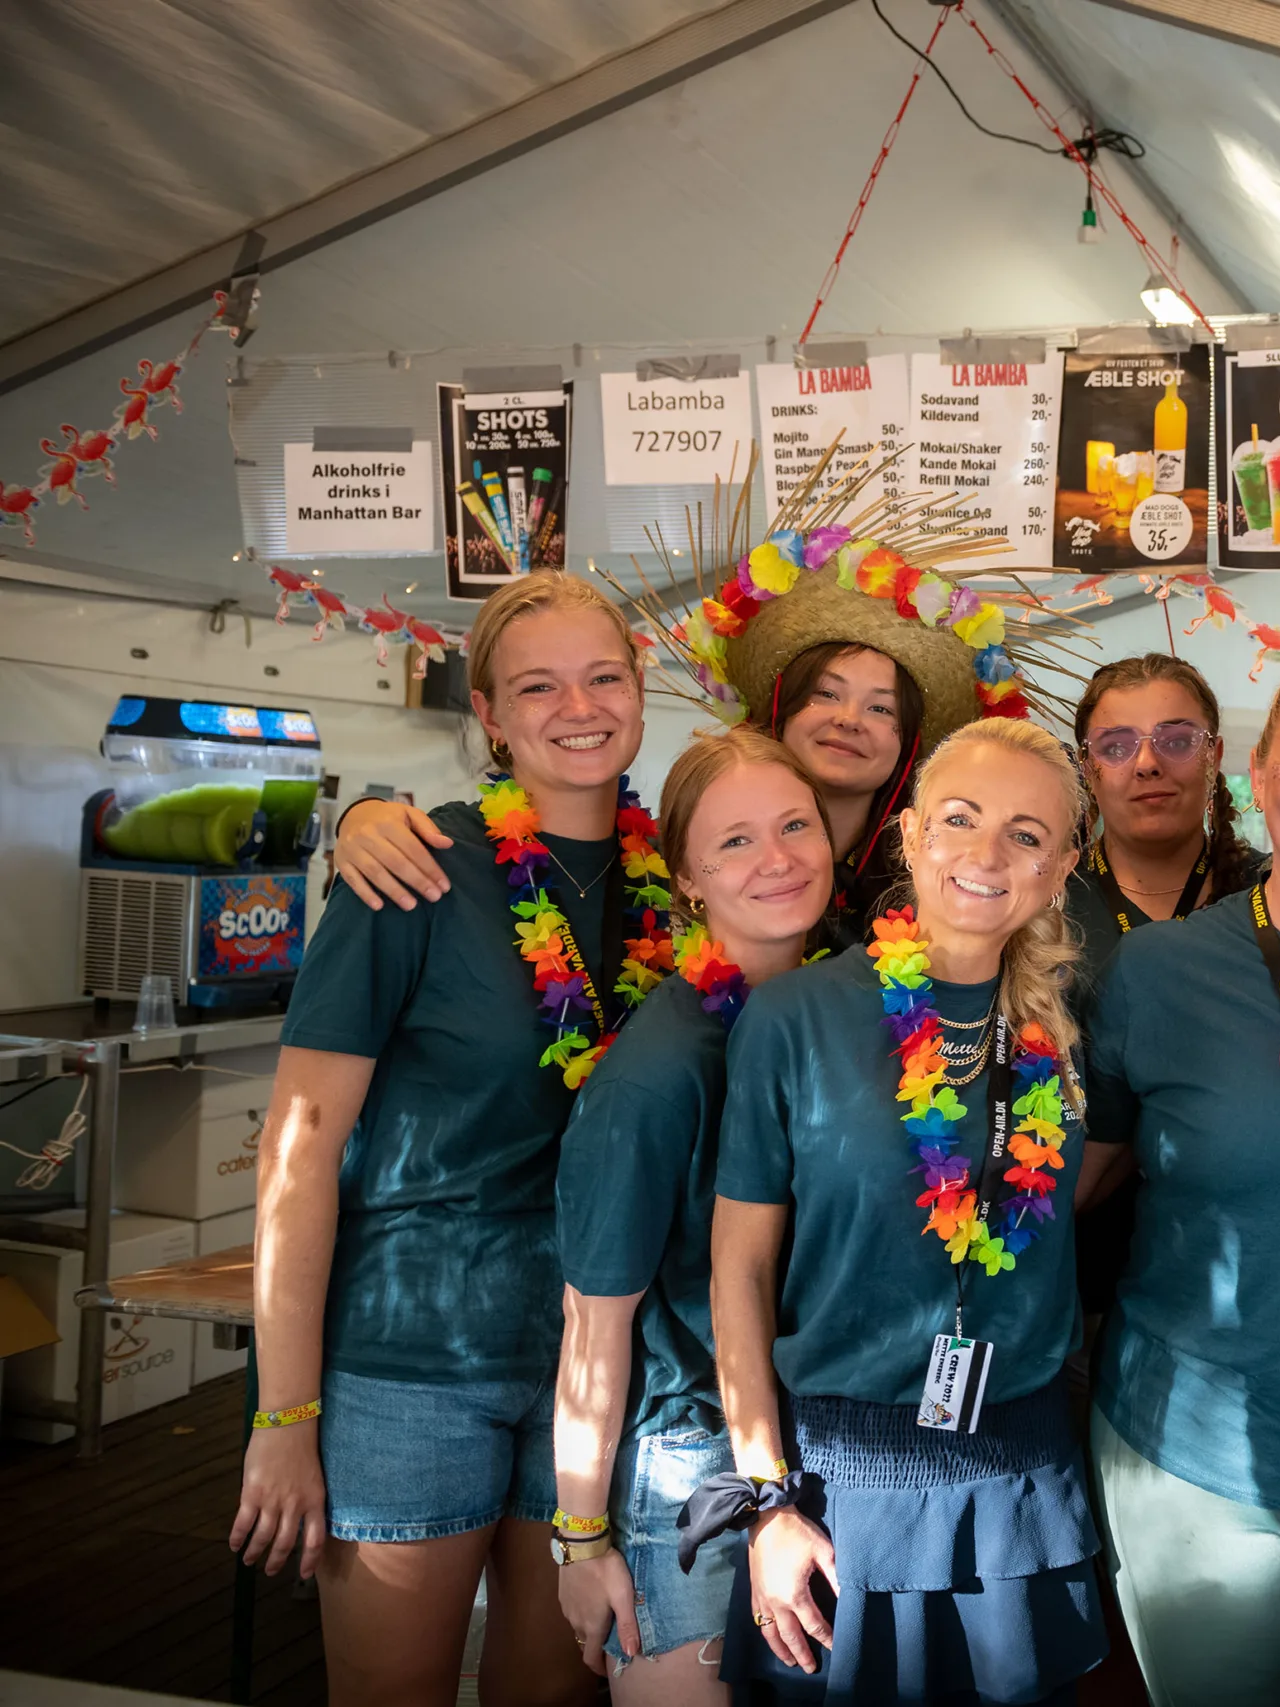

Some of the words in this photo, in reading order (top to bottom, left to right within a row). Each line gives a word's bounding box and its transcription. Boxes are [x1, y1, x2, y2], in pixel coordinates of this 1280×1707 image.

[798, 371, 816, 395] LA
[820, 366, 872, 393] BAMBA
[952, 363, 970, 386] LA
[974, 363, 1028, 386] BAMBA
[1084, 371, 1133, 387] ÆBLE
[1137, 370, 1185, 387] SHOT
[627, 391, 725, 411] Labamba
[921, 393, 979, 406] Sodavand
[1032, 393, 1052, 406] 30,-
[771, 404, 818, 417] DRINKS:
[921, 410, 979, 422] Kildevand
[1031, 409, 1052, 421] 20,-
[477, 409, 549, 431] SHOTS
[632, 430, 722, 453] 727907
[773, 432, 809, 444] Mojito
[881, 424, 904, 436] 50,-
[774, 449, 793, 459] Gin
[837, 442, 874, 454] Smash
[881, 440, 903, 451] 50,-
[920, 442, 1002, 454] Mokai/Shaker
[1031, 442, 1050, 453] 50,-
[312, 463, 406, 478] Alkoholfrie
[920, 458, 957, 470] Kande
[961, 459, 996, 471] Mokai
[1024, 458, 1049, 470] 260,-
[883, 472, 905, 484] 50,-
[920, 474, 950, 485] Refill
[954, 475, 990, 486] Mokai
[1023, 475, 1049, 486] 240,-
[328, 485, 381, 499] drinks
[385, 485, 390, 498] i
[298, 506, 387, 521] Manhattan
[392, 506, 421, 520] Bar
[1028, 506, 1047, 518] 50,-
[1022, 525, 1046, 536] 170,-
[1252, 892, 1268, 928] VARDE
[1117, 913, 1132, 933] OPE
[592, 1000, 604, 1030] PEN
[940, 1041, 978, 1054] Mette
[996, 1014, 1007, 1064] OPEN-AIR.DK
[992, 1101, 1006, 1157] OPEN-AIR.DK
[948, 1354, 959, 1383] CREW
[942, 1384, 953, 1403] 2022
